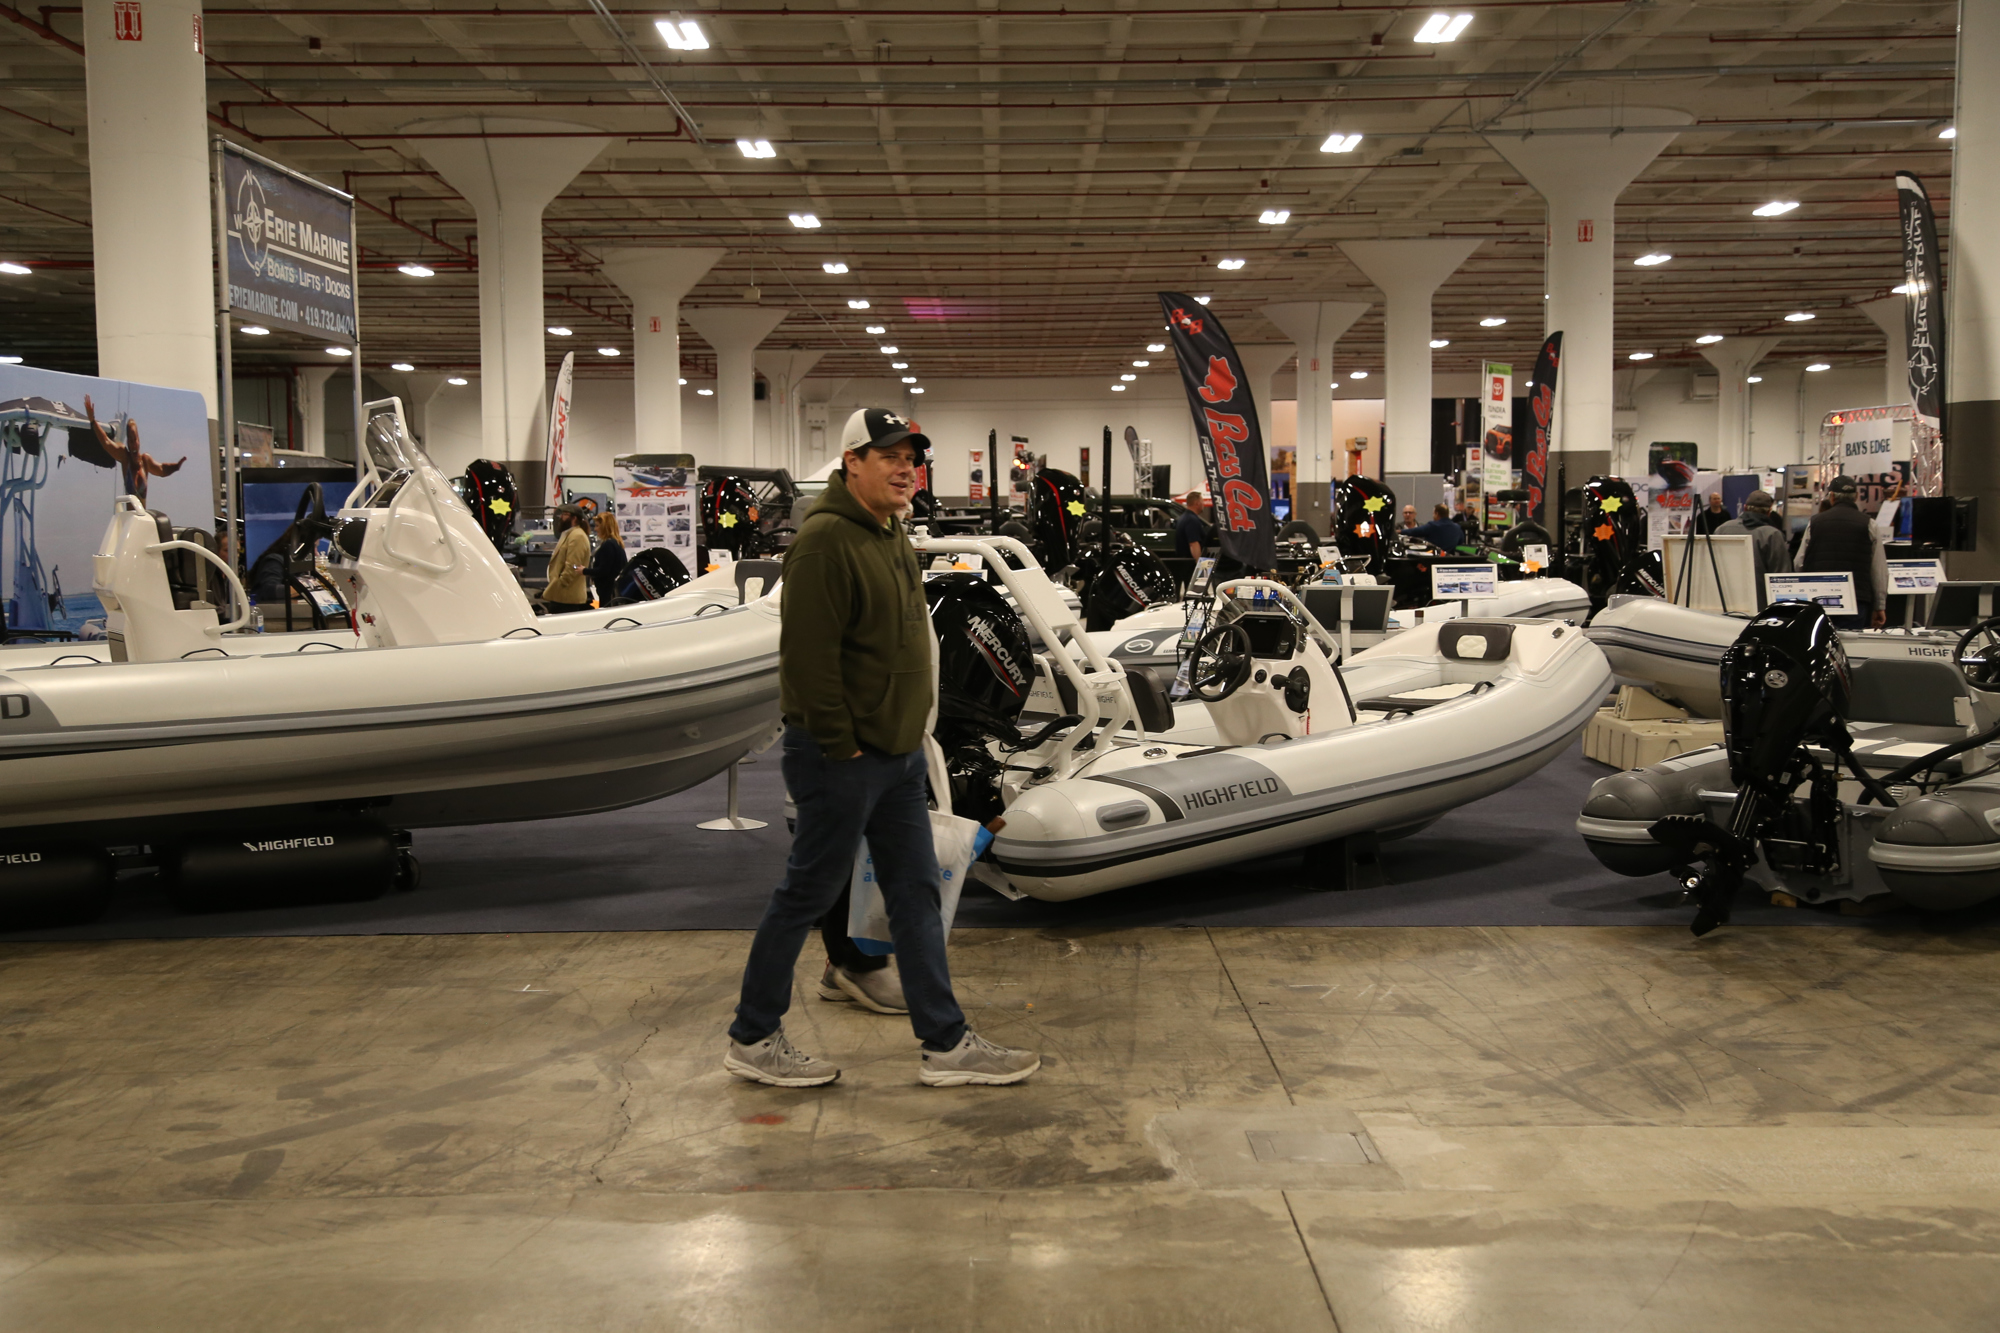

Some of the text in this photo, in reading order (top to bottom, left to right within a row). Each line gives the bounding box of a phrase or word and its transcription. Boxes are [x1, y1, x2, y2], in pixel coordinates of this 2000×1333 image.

[264, 207, 349, 265] ERIE MARINE
[267, 257, 351, 300] BOATS LIFTS DOCKS
[1845, 438, 1891, 457] BAYS EDGE
[1203, 406, 1264, 533] Bass Cat
[1116, 564, 1152, 602] MERCURY
[967, 615, 1027, 686] MERCURY
[1183, 777, 1279, 810] HIGHFIELD
[0, 852, 42, 864] FIELD
[258, 836, 335, 852] HIGHFIELD
